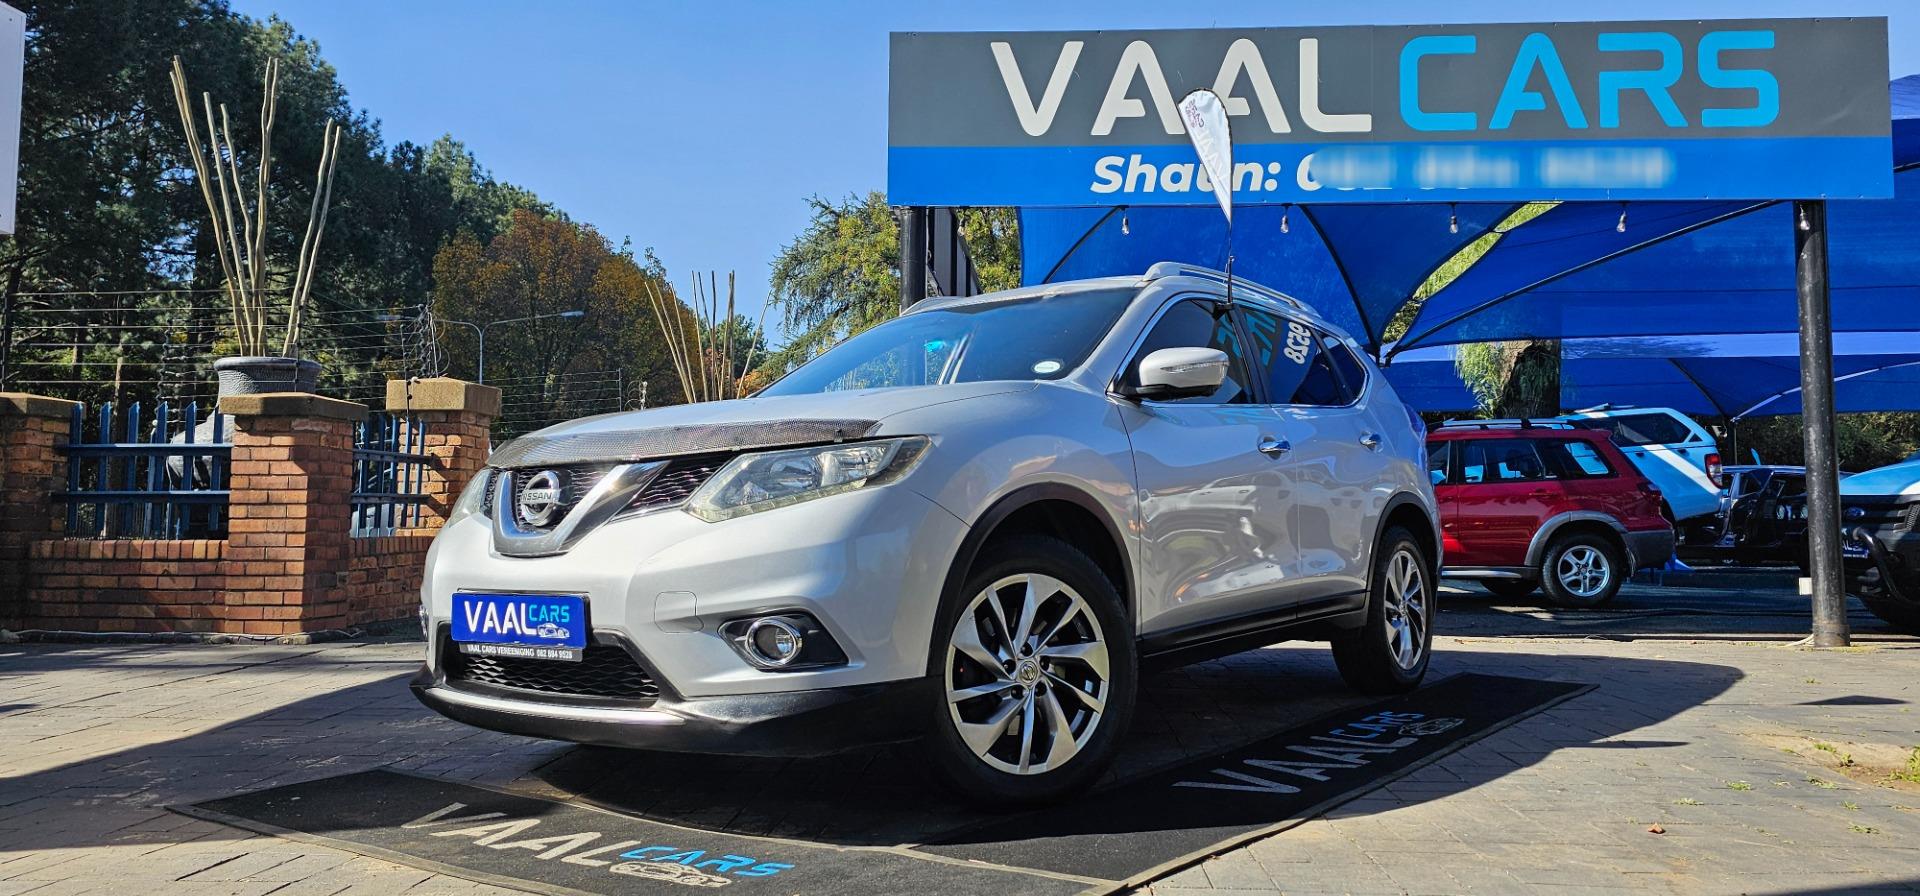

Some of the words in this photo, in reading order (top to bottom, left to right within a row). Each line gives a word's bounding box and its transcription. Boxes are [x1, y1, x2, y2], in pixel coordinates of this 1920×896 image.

[990, 38, 1372, 137] VAAL
[1400, 30, 1779, 132] CARS
[522, 492, 553, 501] NISSAN
[464, 600, 538, 636] VAAL
[528, 604, 570, 622] CARS
[467, 643, 482, 653] VAAL
[481, 645, 497, 655] CARS
[1171, 735, 1419, 794] VAAL
[1329, 711, 1426, 739] CARS
[400, 802, 643, 867] VAAL
[618, 846, 797, 878] CARS
